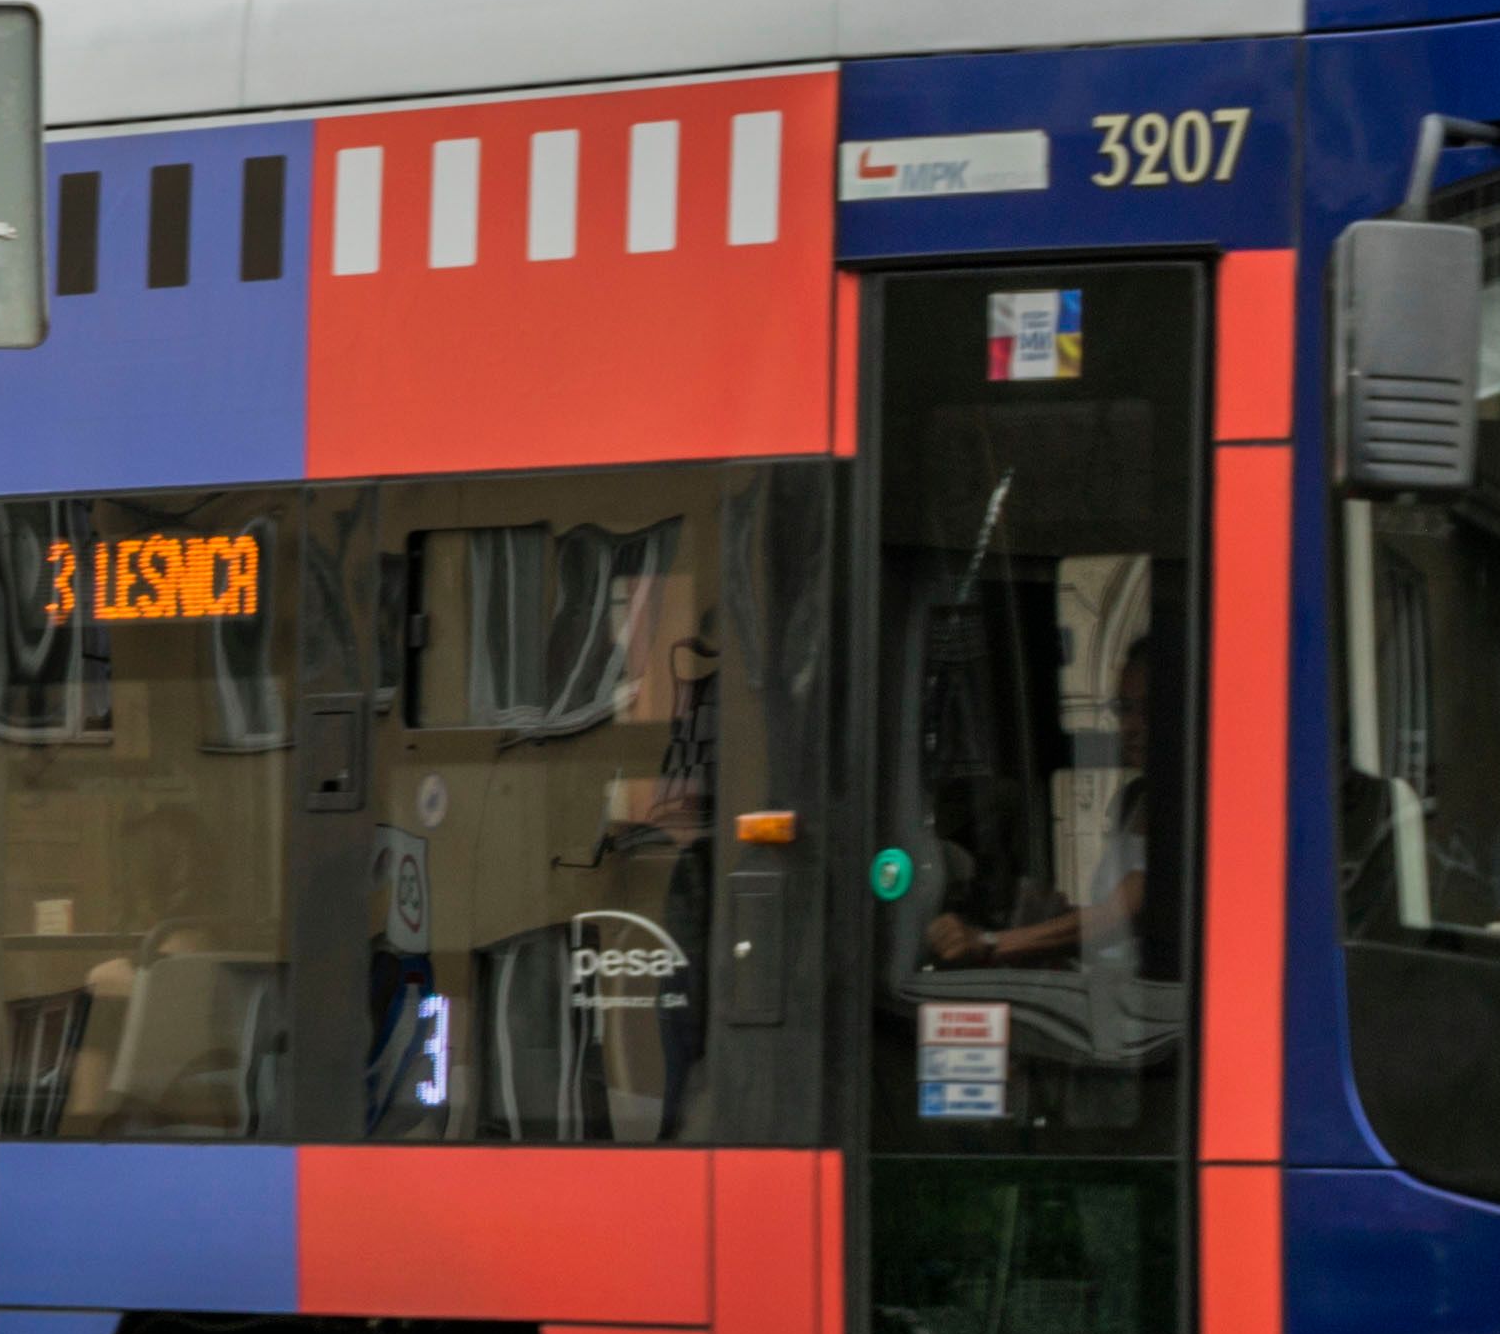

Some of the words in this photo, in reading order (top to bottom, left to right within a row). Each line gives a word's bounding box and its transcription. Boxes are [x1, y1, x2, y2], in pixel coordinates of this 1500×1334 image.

[902, 160, 970, 191] MPK
[1090, 107, 1252, 187] 3207
[45, 540, 76, 626] 3
[570, 948, 676, 985] pesa
[416, 994, 449, 1105] 3
